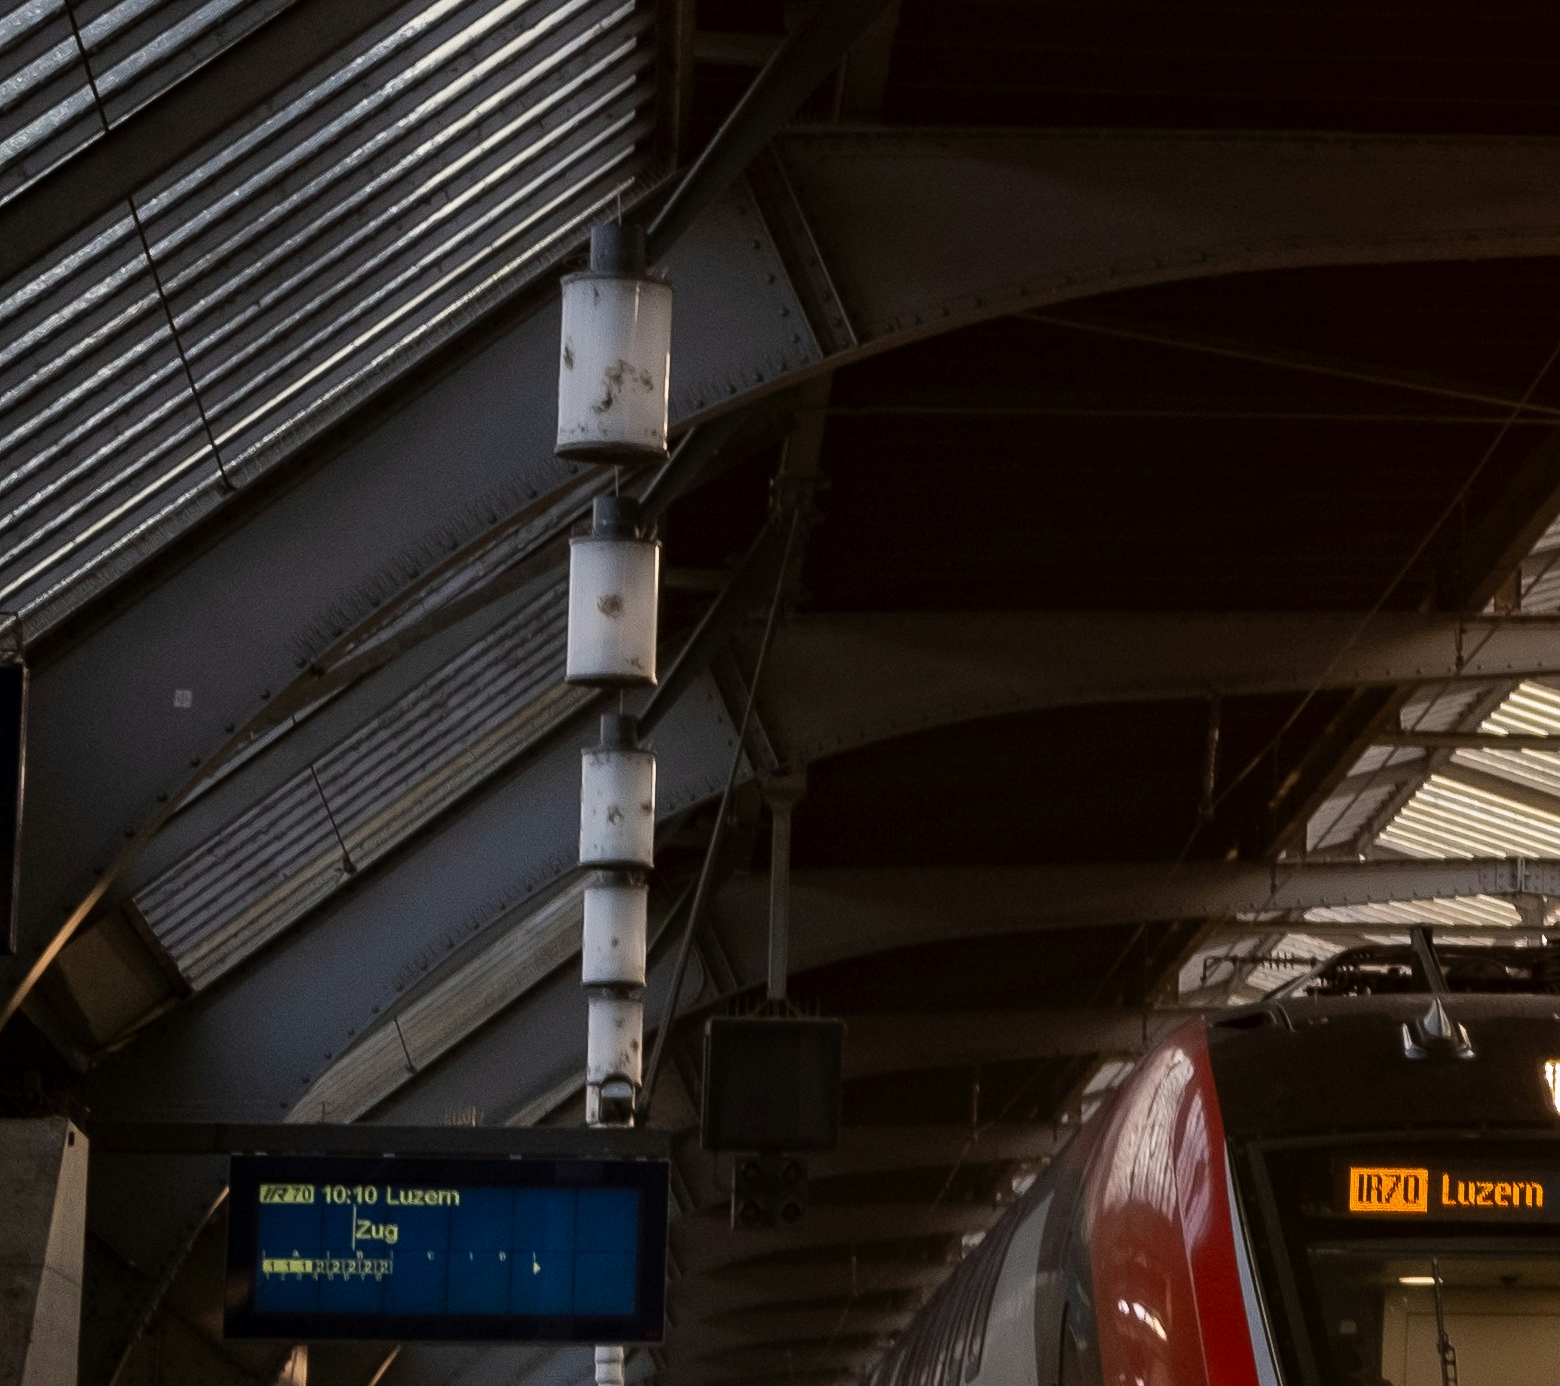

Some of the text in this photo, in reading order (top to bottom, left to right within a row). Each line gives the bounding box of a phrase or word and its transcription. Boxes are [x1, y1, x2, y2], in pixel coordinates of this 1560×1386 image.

[322, 1185, 378, 1205] 10:10
[386, 1184, 460, 1206] Luzern
[1357, 1172, 1544, 1207] IR70 Luzern
[355, 1219, 399, 1245] Zug
